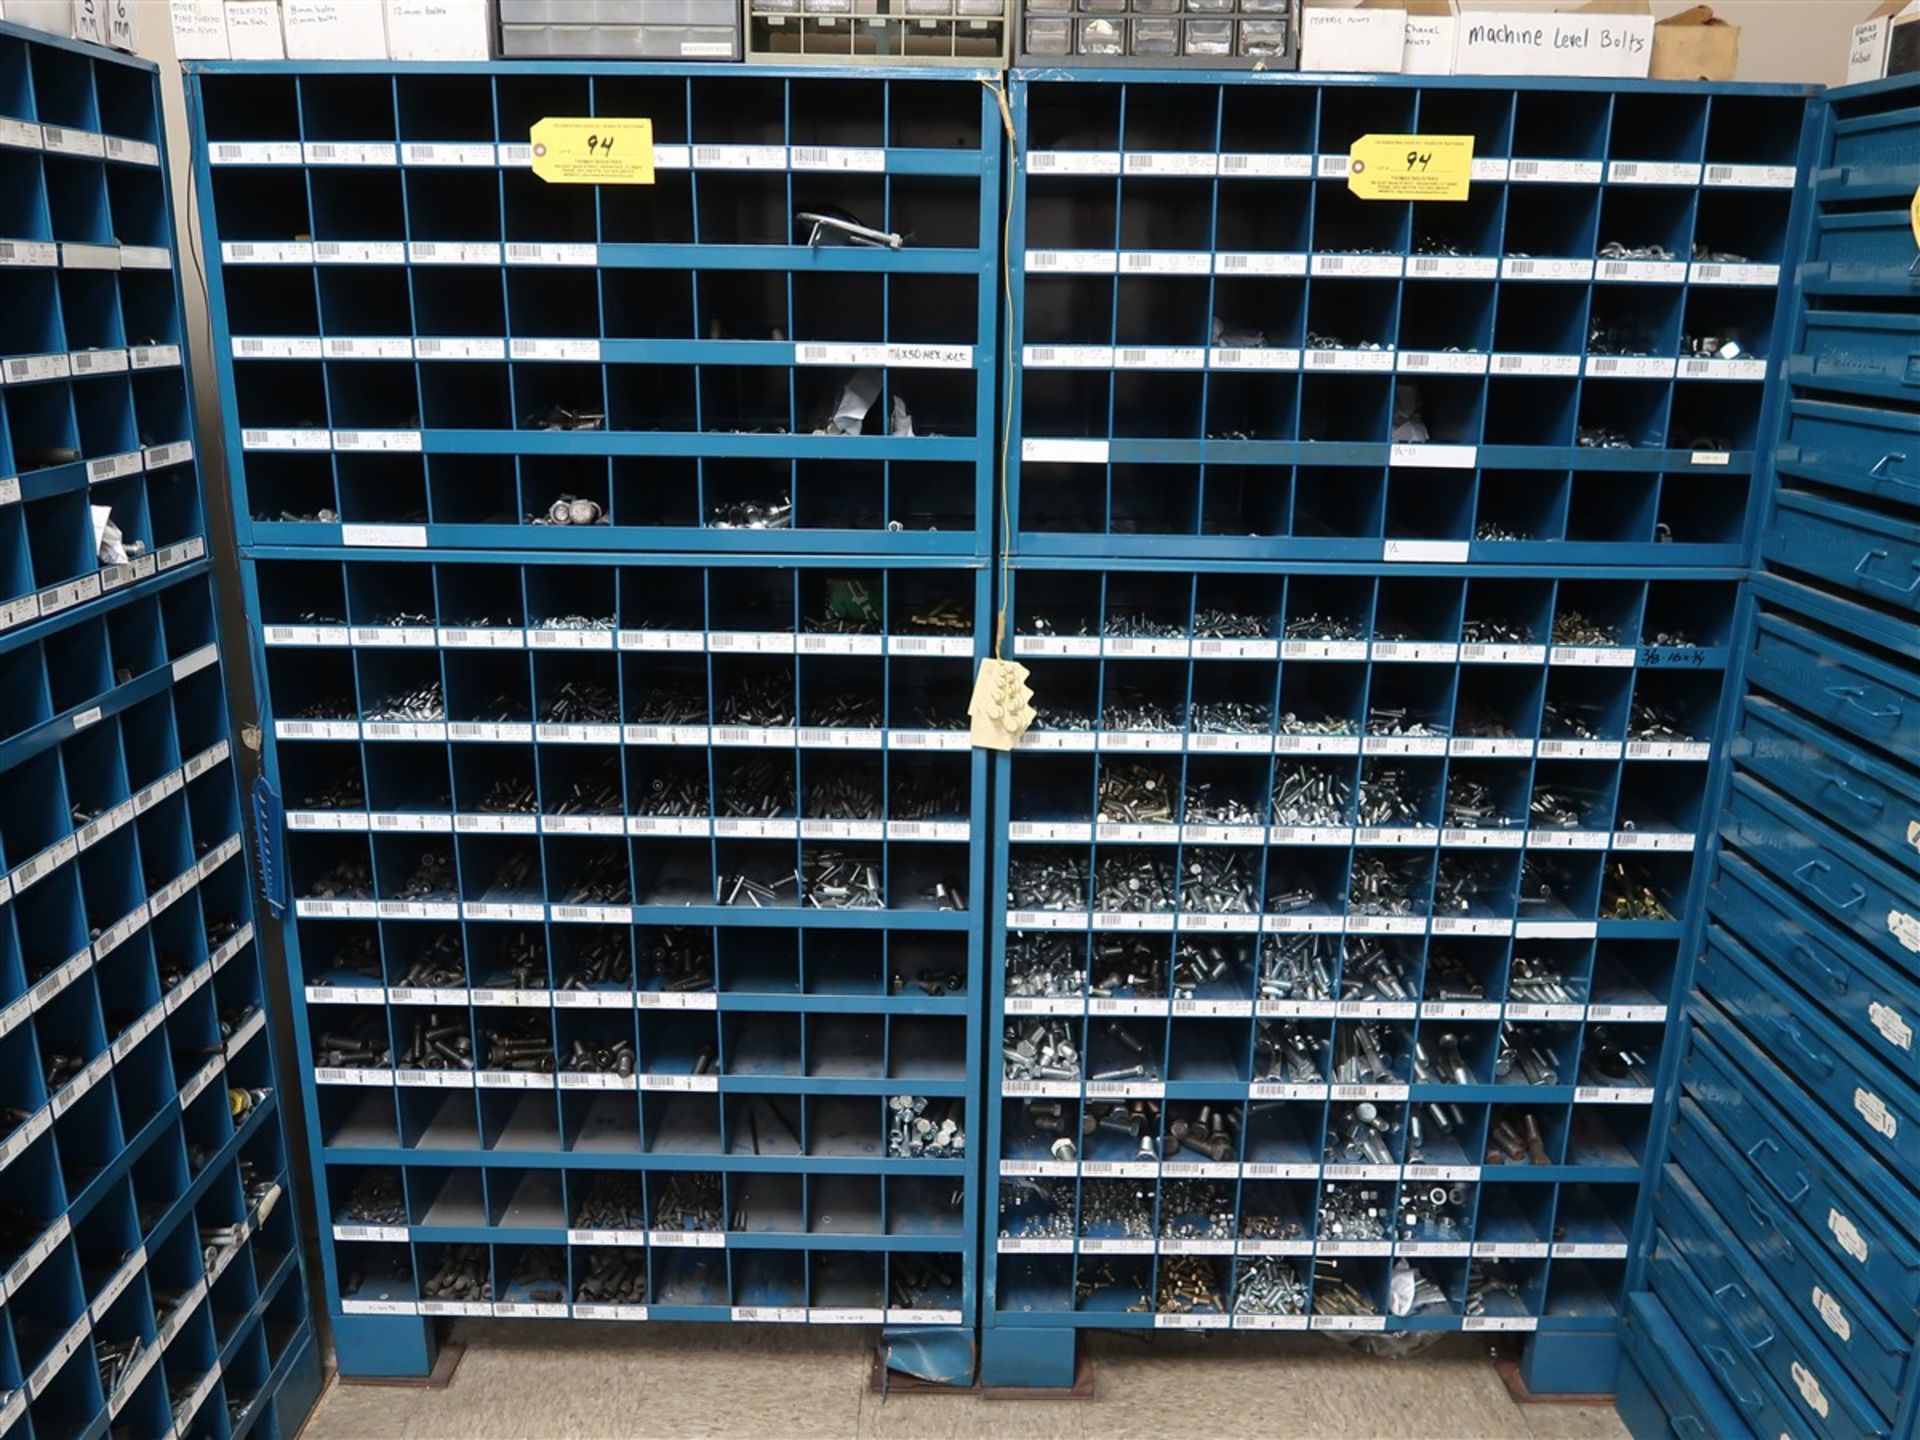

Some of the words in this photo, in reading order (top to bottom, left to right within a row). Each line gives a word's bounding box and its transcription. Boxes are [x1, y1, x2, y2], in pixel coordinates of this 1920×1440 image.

[1469, 24, 1543, 46] Machine
[1554, 27, 1589, 49] Level
[1600, 29, 1646, 54] Bolts
[587, 134, 614, 157] 94
[1406, 151, 1433, 172] 94
